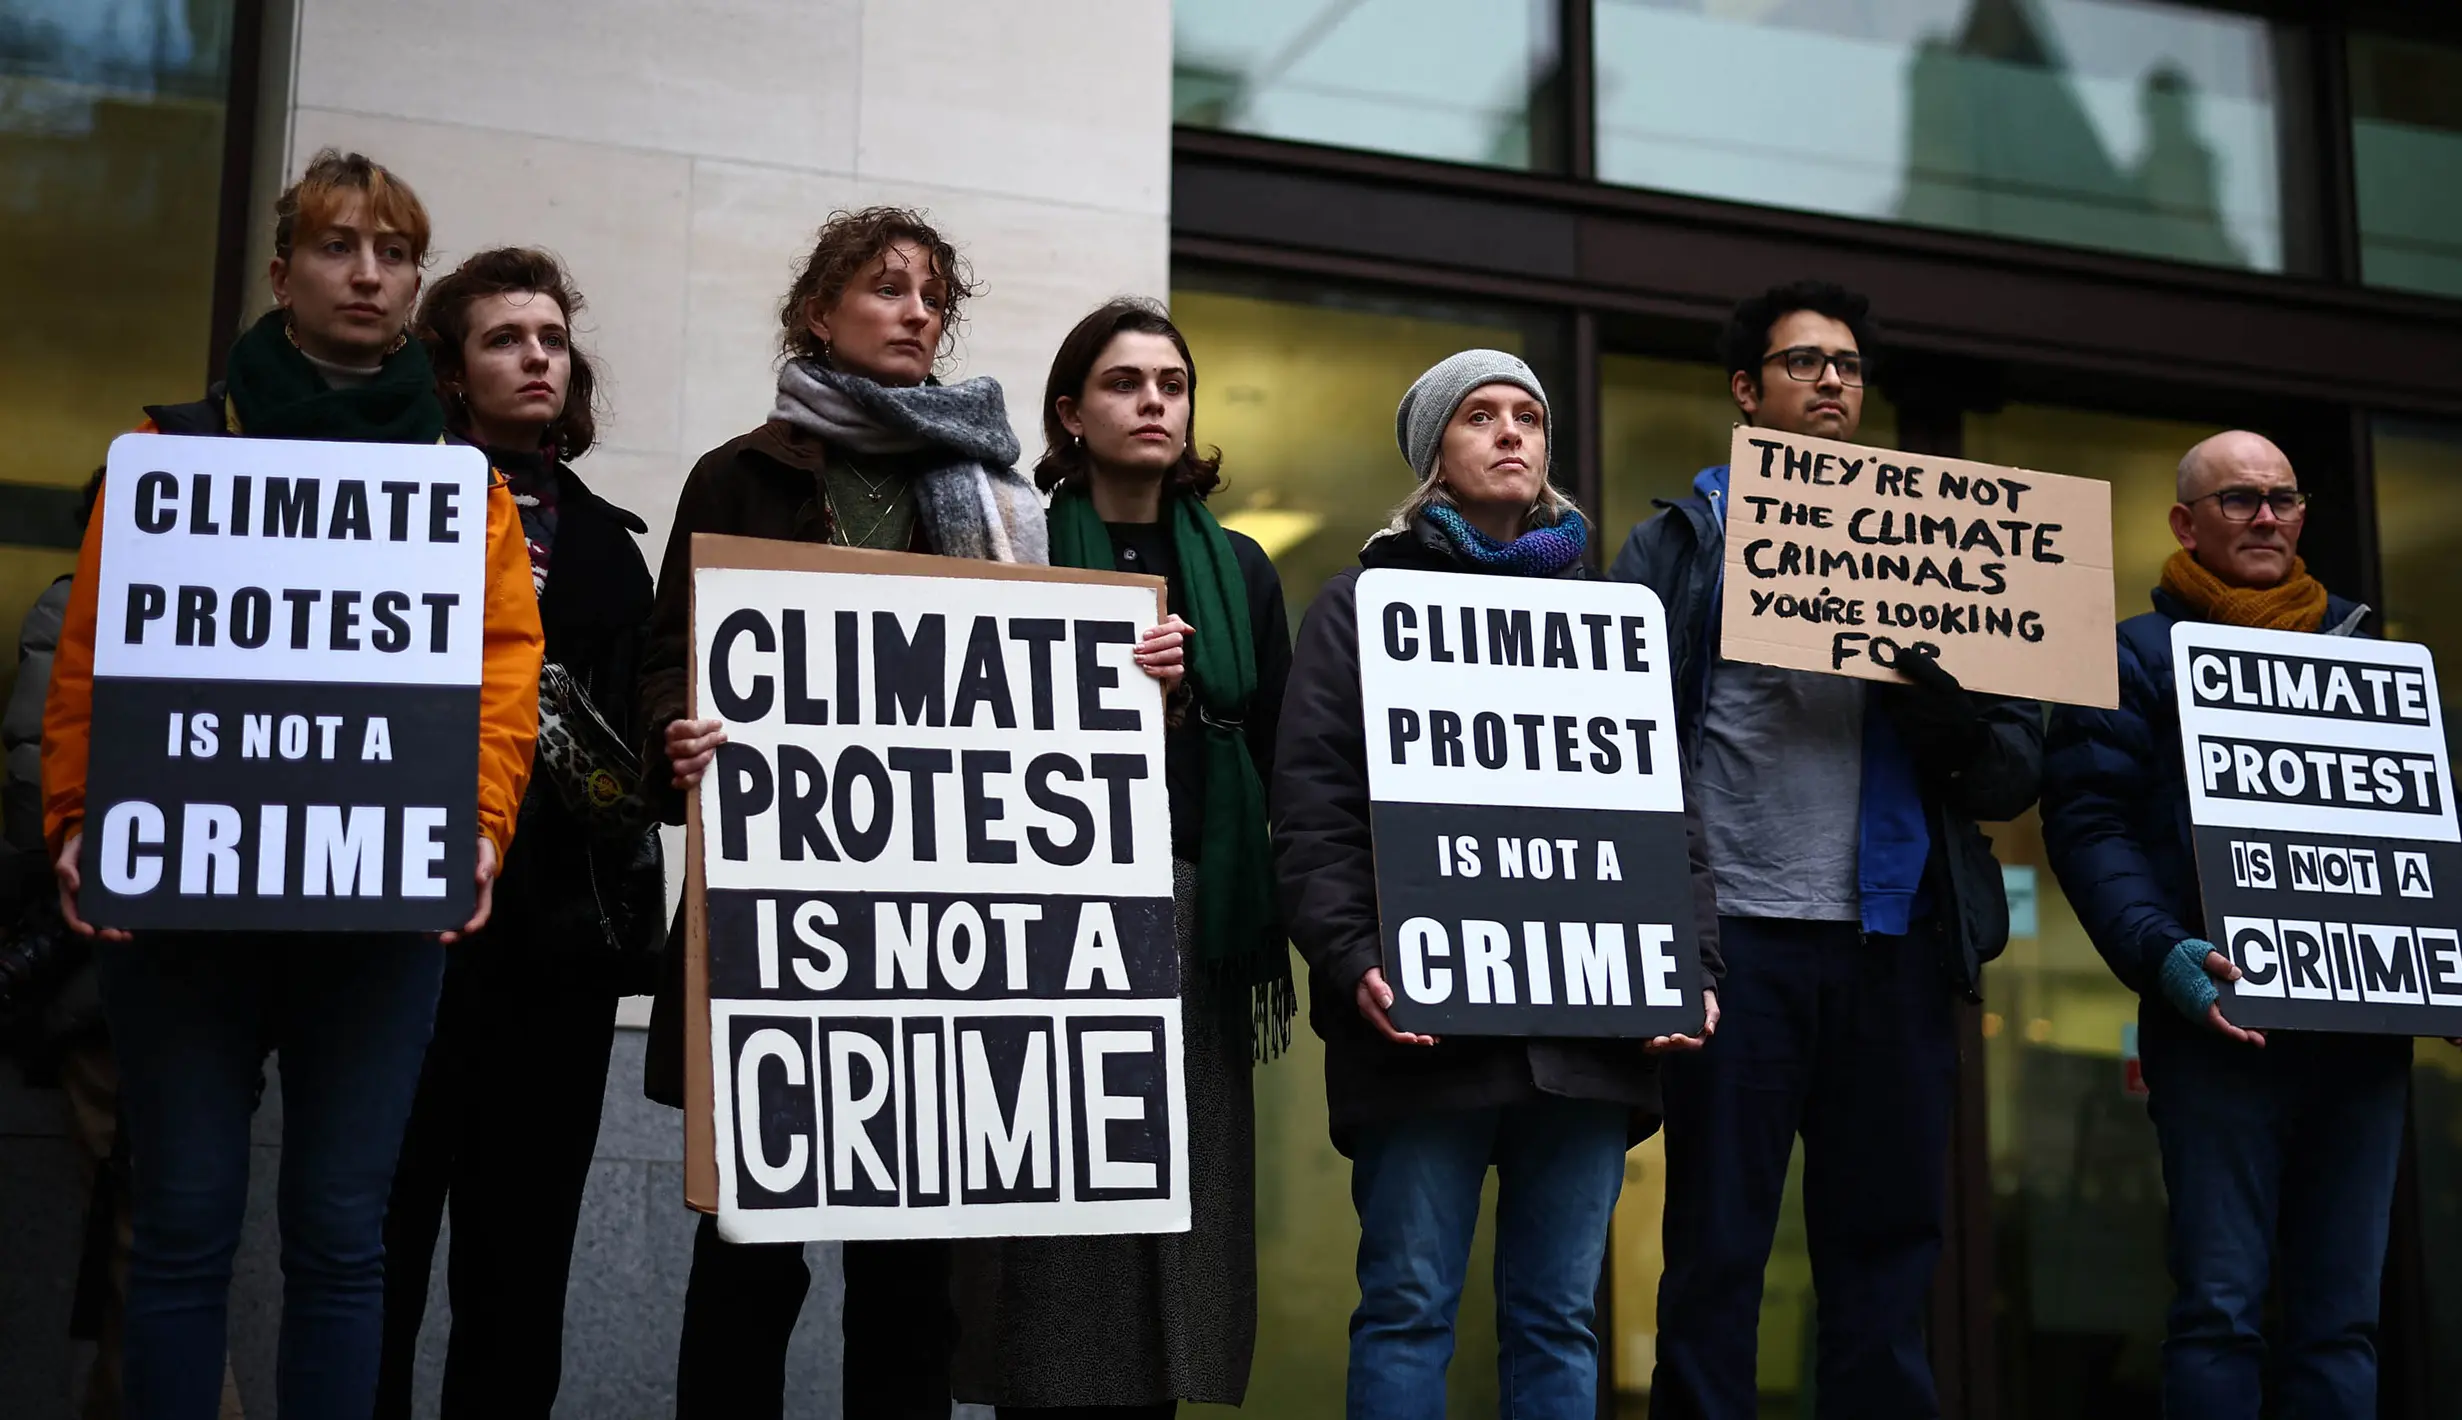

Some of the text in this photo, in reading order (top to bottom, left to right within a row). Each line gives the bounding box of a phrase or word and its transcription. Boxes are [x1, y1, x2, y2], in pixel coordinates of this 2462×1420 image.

[134, 470, 461, 544] CLIMATE
[1748, 438, 2031, 513] THEY'RE NOT
[1743, 496, 2064, 563] THE CLIMATE
[1744, 539, 2006, 594] CRIMINALS
[124, 583, 461, 654] PROTEST
[1382, 601, 1650, 673] CLIMATE
[1750, 587, 2045, 642] YOU'RE LOOKING
[709, 608, 1142, 731] CLIMATE
[2192, 653, 2428, 720] CLIMATE
[167, 712, 394, 761] IS NOT A
[1387, 707, 1657, 775] PROTEST
[717, 741, 1148, 866] PROTEST
[2200, 741, 2435, 808] PROTEST
[100, 800, 448, 897] CRIME
[1437, 835, 1622, 881] IS NOT A
[2234, 846, 2430, 891] IS NOT A
[756, 899, 1132, 992] IS NOT A
[1398, 916, 1683, 1007] CRIME
[2231, 927, 2462, 995] CRIME
[737, 1027, 1158, 1193] CRIME
